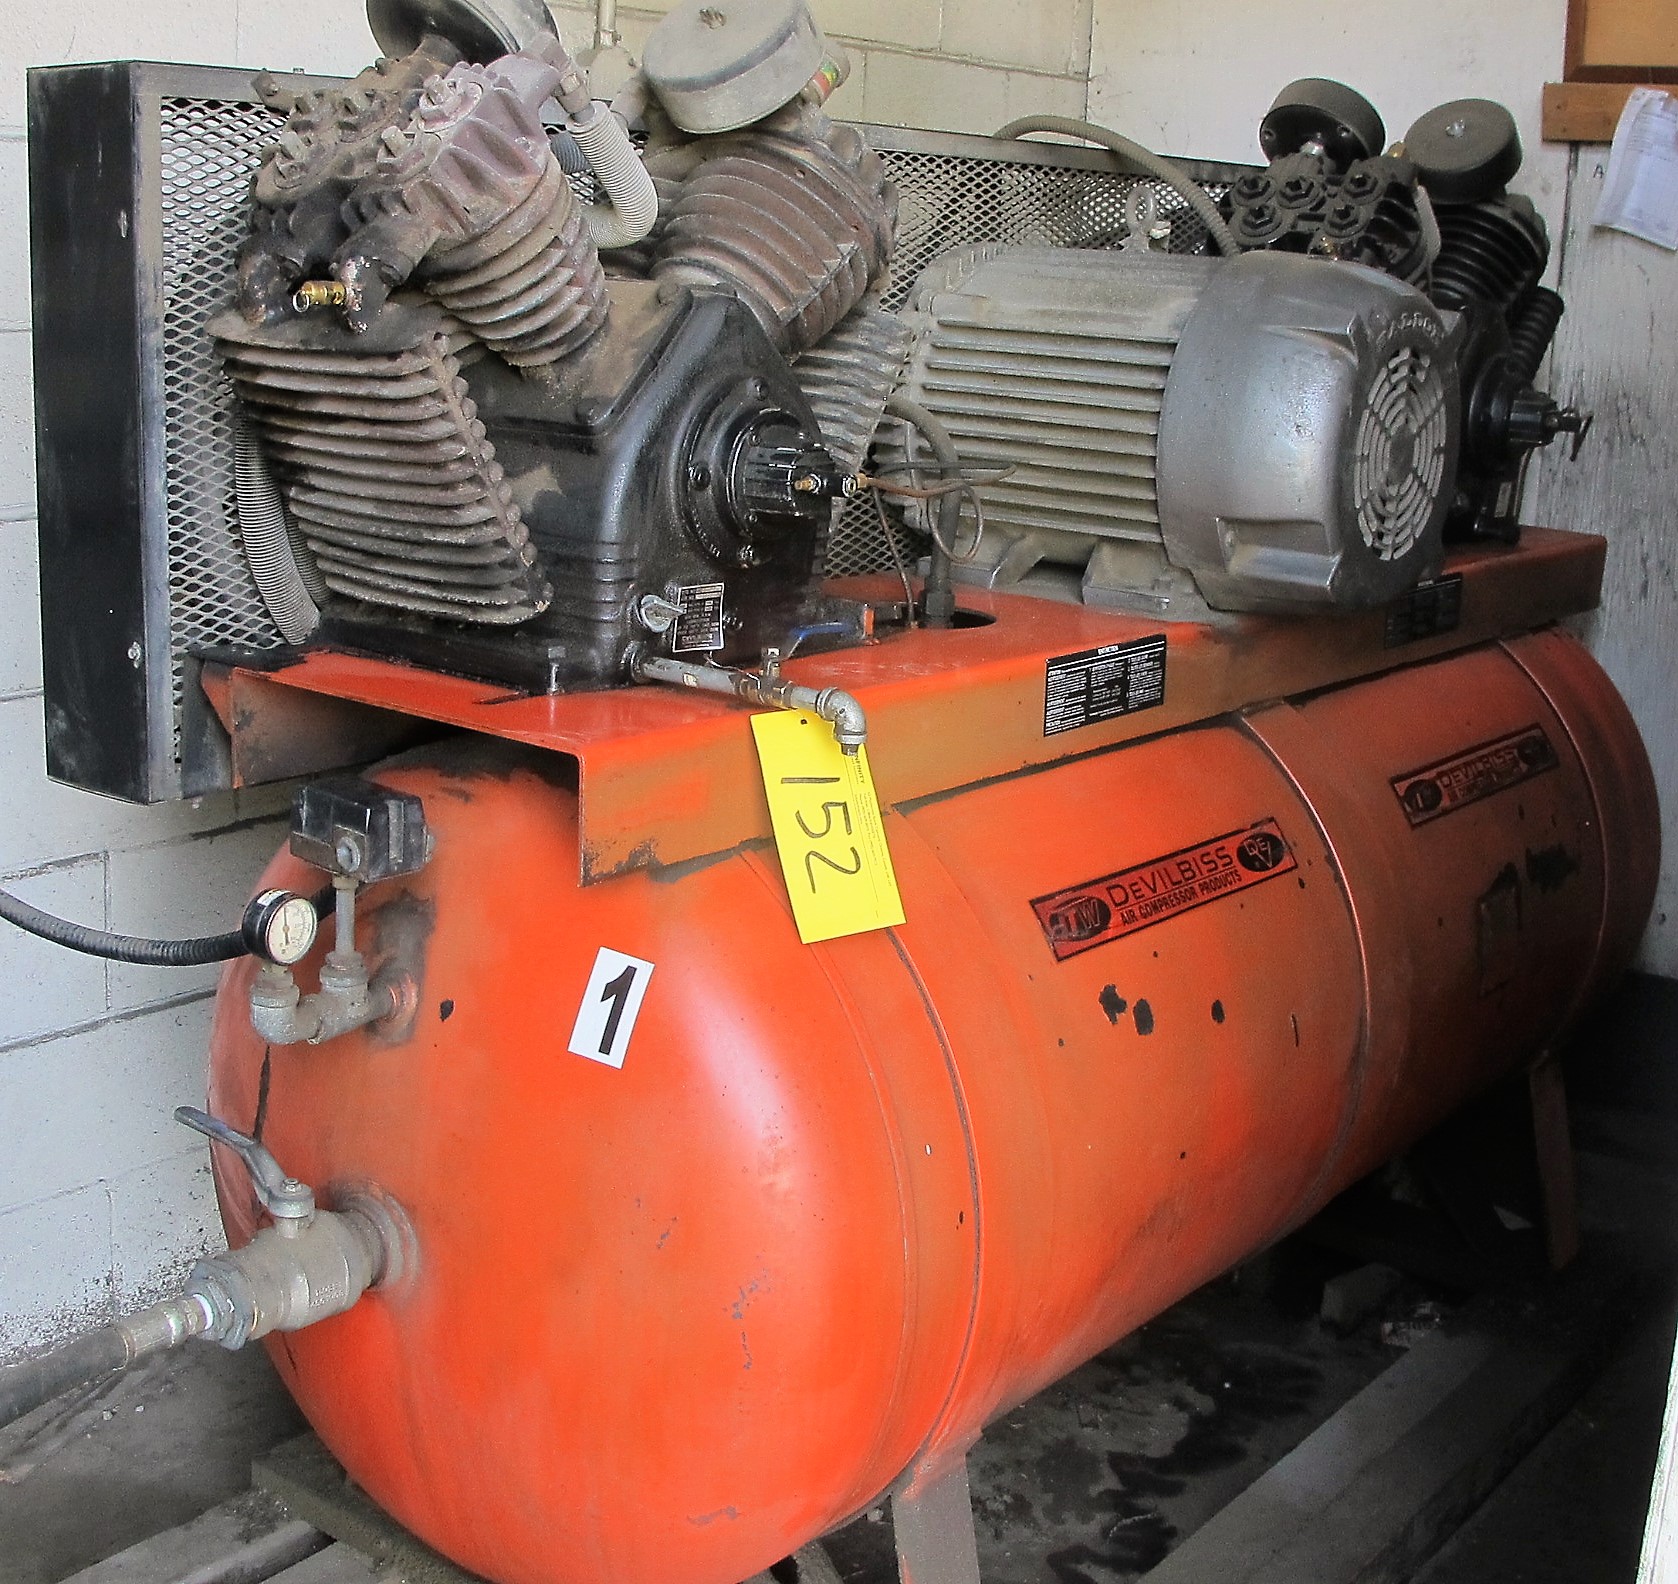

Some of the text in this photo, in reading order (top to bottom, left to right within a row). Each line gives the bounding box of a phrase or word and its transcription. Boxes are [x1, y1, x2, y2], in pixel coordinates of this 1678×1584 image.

[781, 777, 861, 894] 152
[1106, 846, 1233, 907] DEVILBISS
[1120, 869, 1242, 926] AIR COMPRESSOR PRODUCTS
[598, 965, 637, 1055] 1
